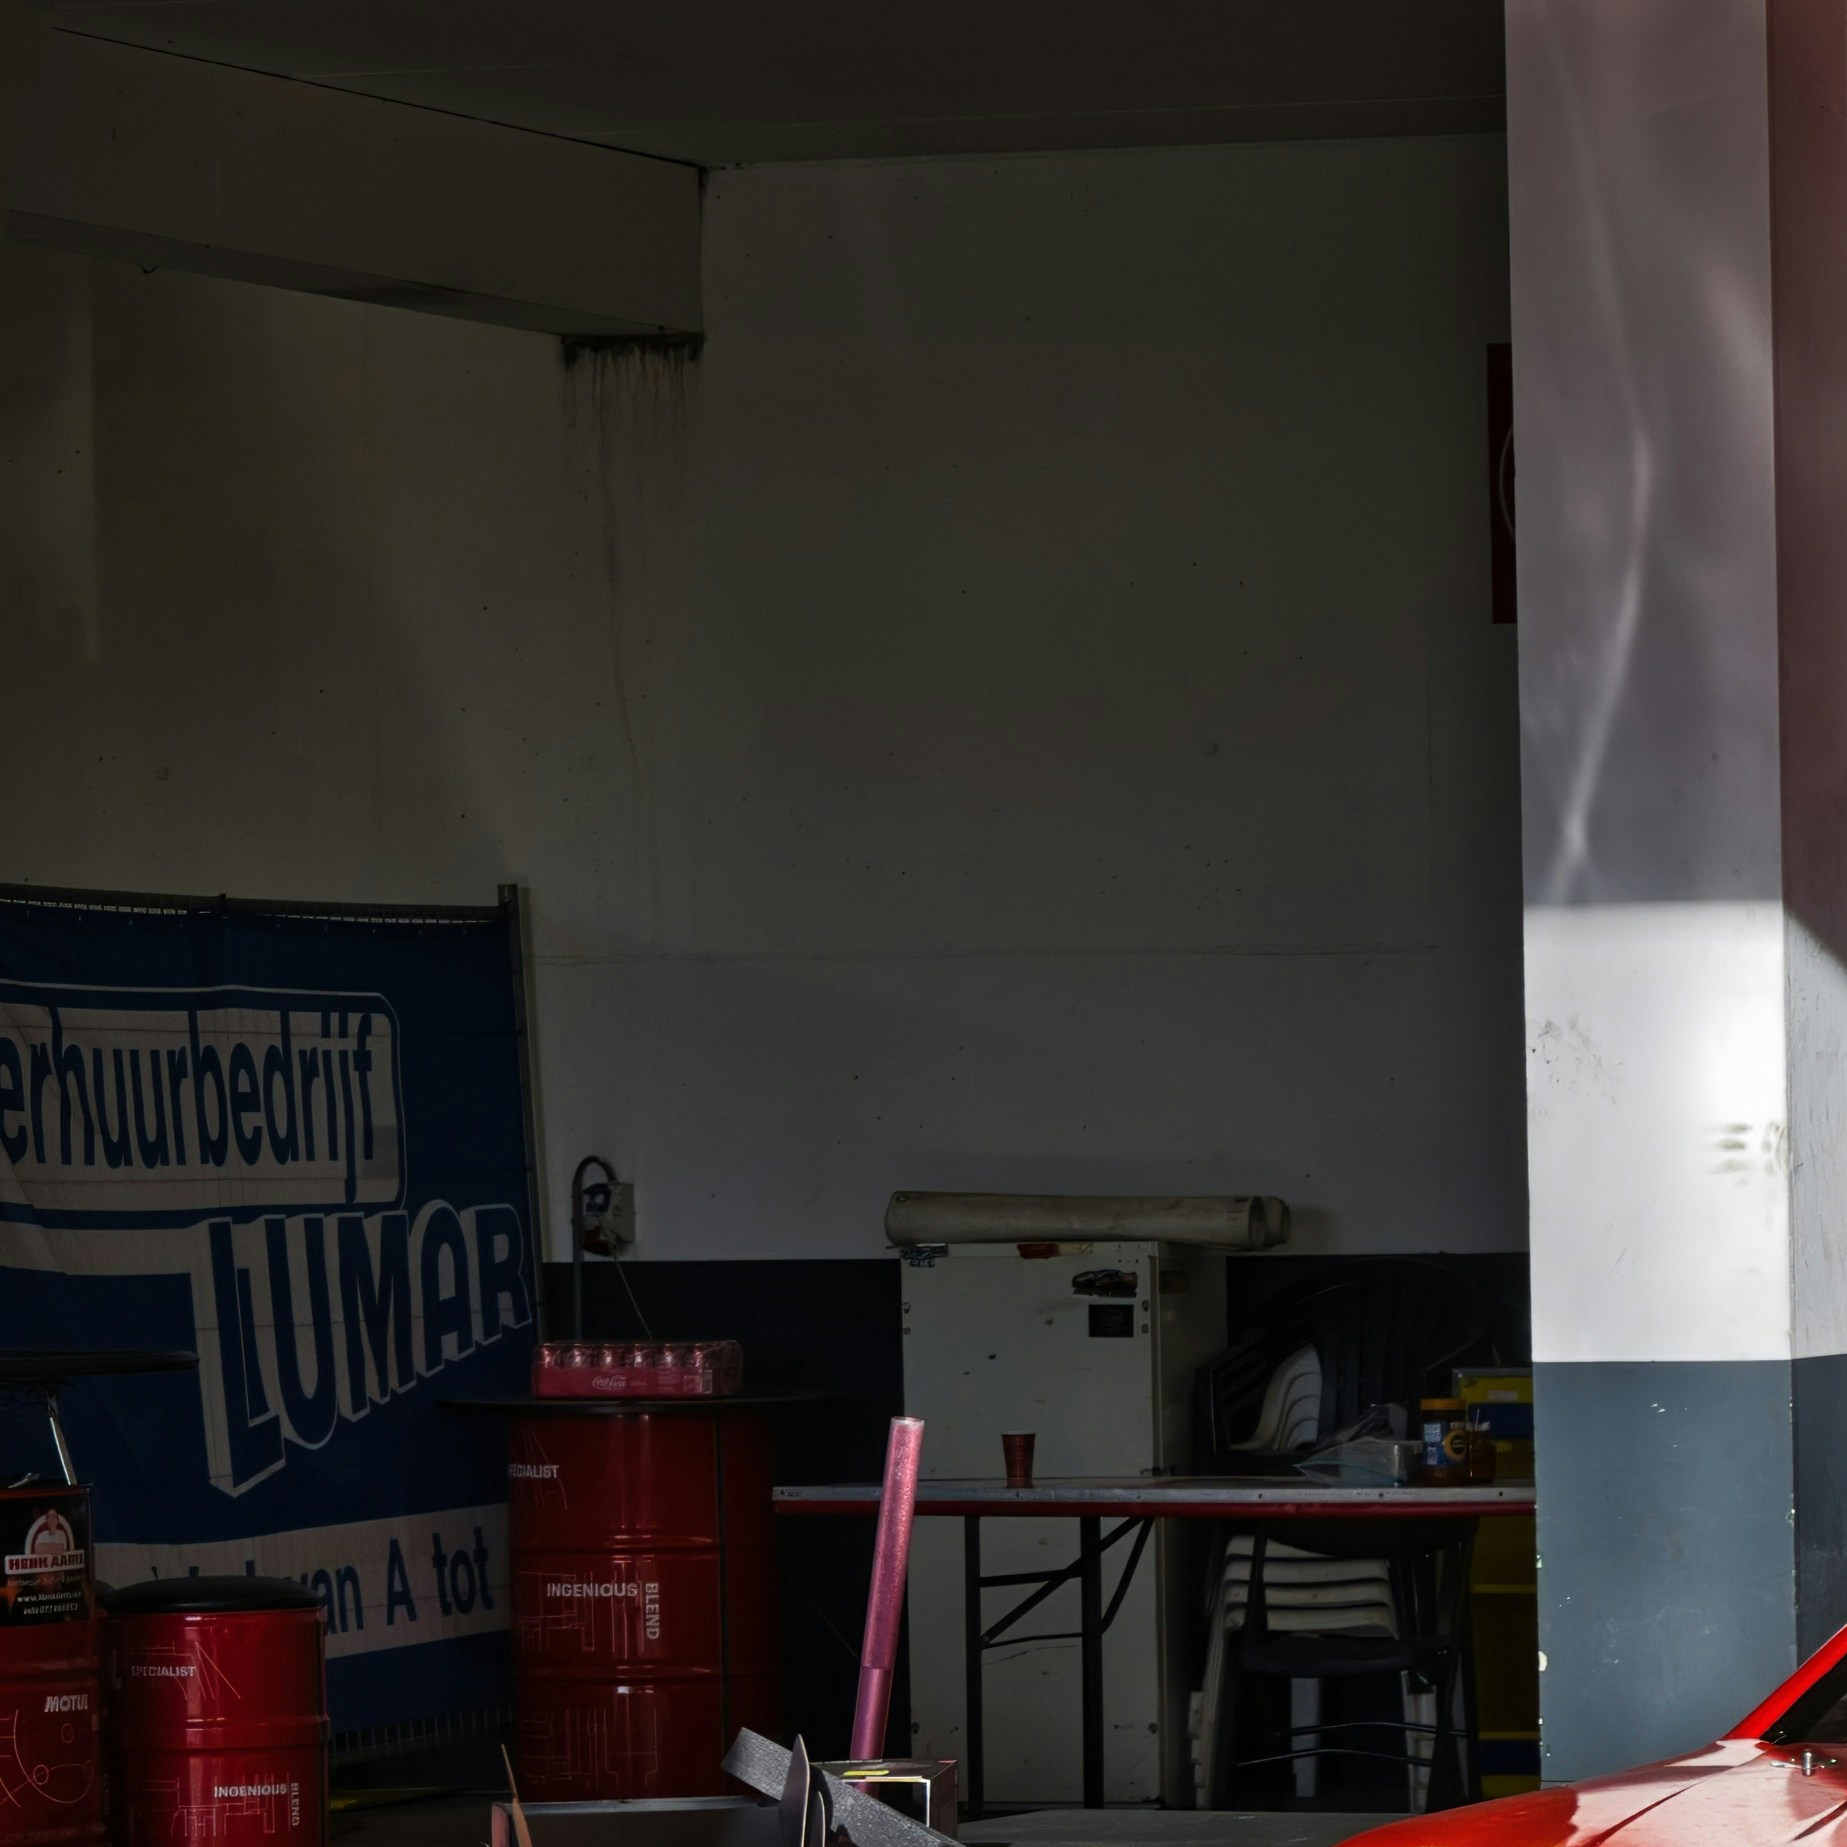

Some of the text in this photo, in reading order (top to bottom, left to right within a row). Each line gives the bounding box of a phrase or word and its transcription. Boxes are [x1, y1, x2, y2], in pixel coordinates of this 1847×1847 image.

[192, 1199, 533, 1497] LUMAR
[386, 1538, 416, 1625] A
[430, 1527, 495, 1618] tot
[546, 1582, 661, 1640] INGENIOUS BLEND
[214, 1782, 300, 1826] INGENIOUS BLEND
